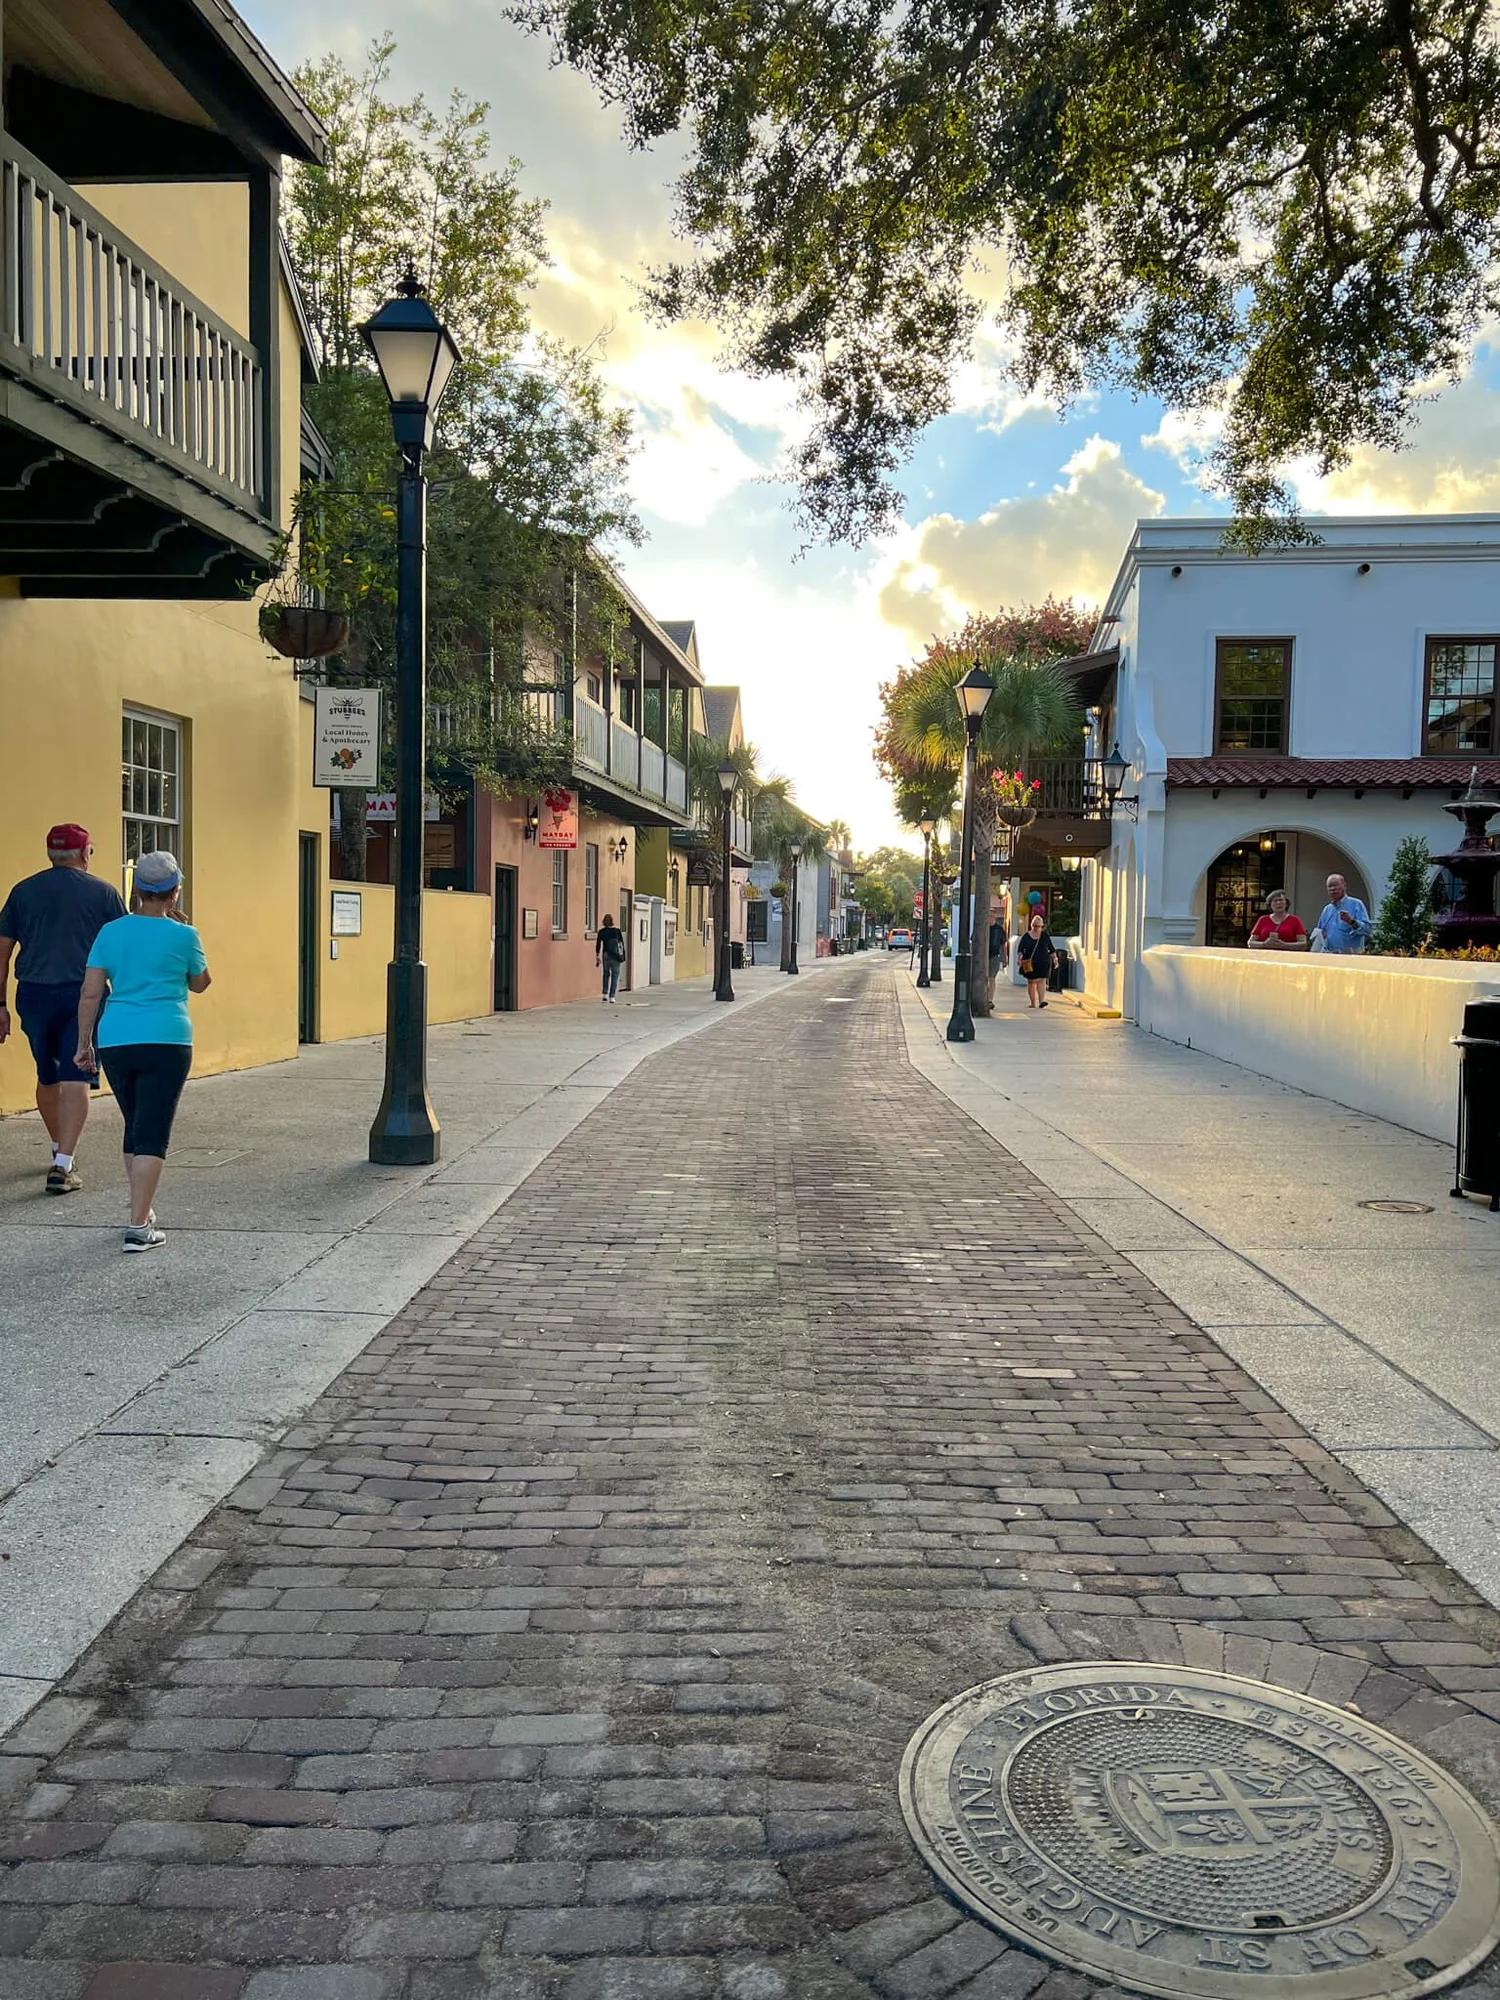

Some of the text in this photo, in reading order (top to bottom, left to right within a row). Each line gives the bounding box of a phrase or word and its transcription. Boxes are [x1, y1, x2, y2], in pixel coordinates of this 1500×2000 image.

[329, 737, 371, 746] Apothecary
[345, 730, 369, 738] Honey
[996, 1685, 1196, 1734] FLORIDA
[1299, 1705, 1438, 1791] MADE IN USA
[1280, 1756, 1376, 1852] SEWER
[1352, 1763, 1436, 1828] 1565
[937, 1824, 1023, 1908] FOUNDRY
[957, 1763, 1453, 1970] CITY OF ST AUGUSTINE
